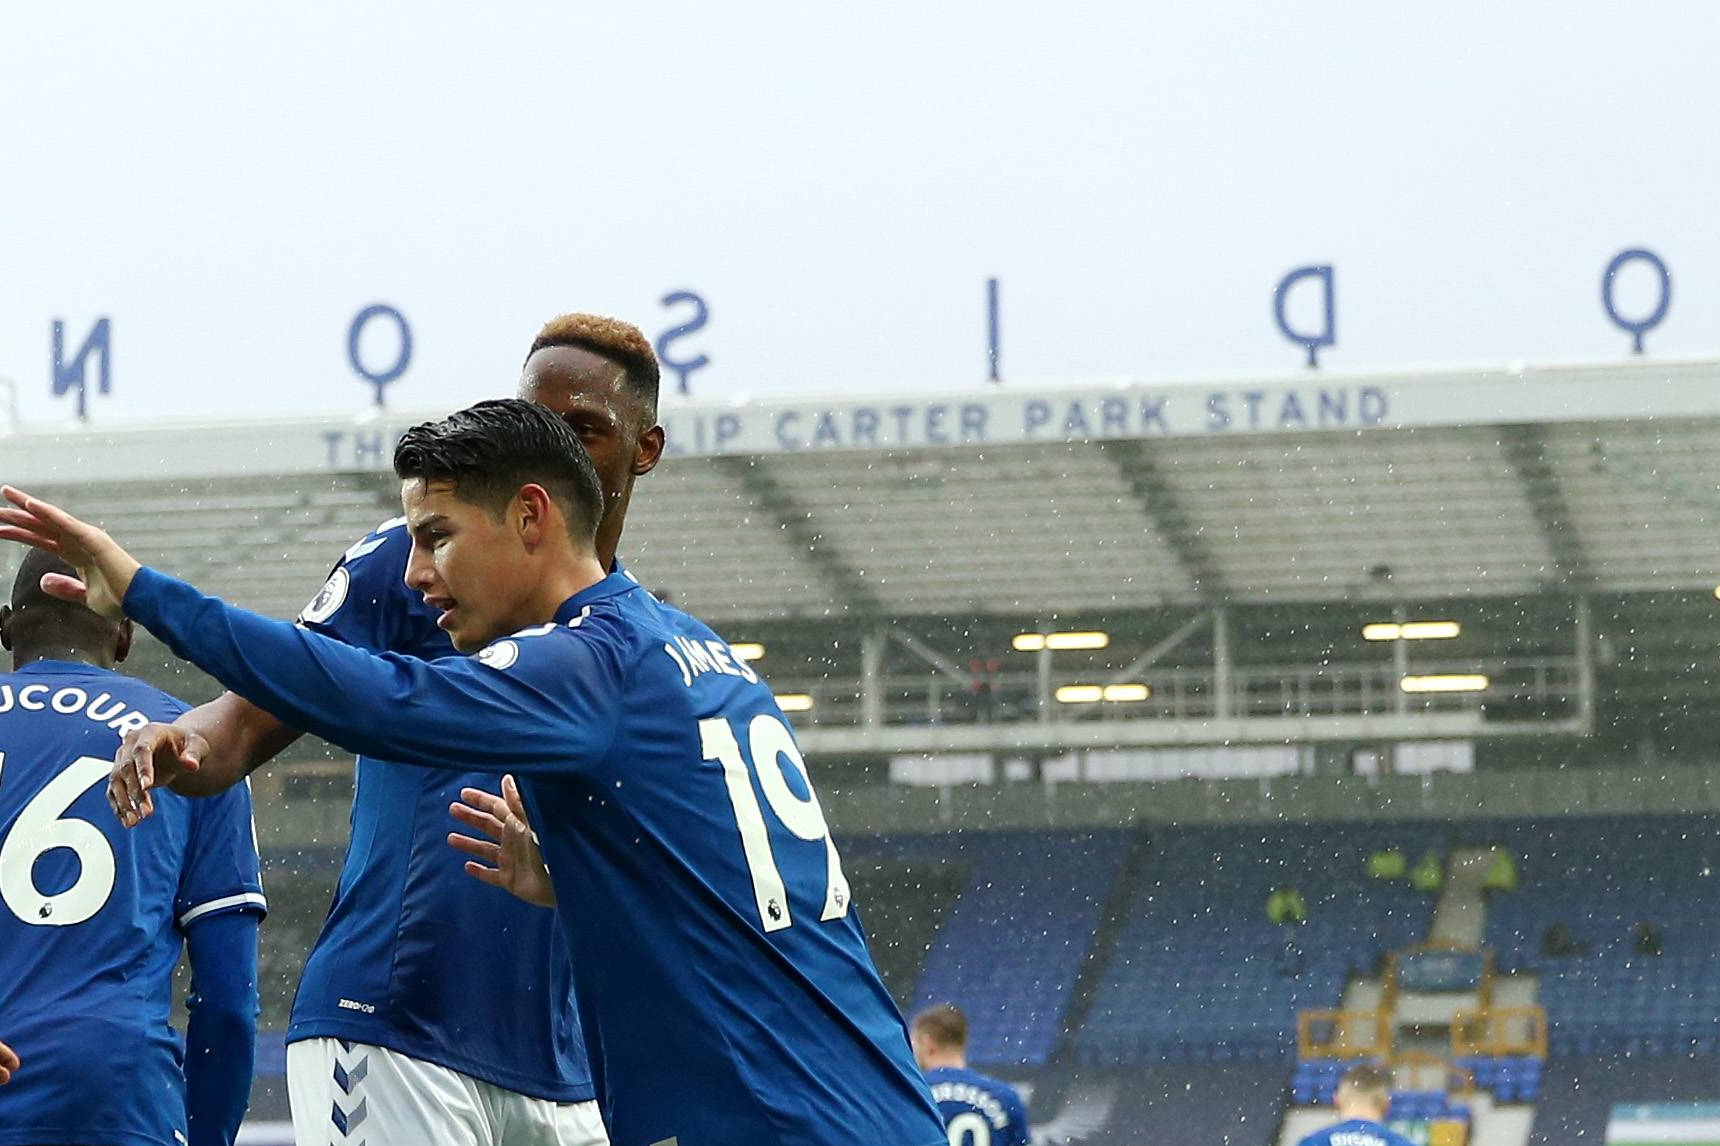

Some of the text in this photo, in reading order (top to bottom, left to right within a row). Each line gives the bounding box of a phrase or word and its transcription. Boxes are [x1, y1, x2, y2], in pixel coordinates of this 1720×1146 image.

[664, 413, 741, 454] LIP
[777, 403, 991, 450] CARTER
[1023, 394, 1169, 440] PARK
[1205, 385, 1392, 427] STAND
[698, 714, 852, 932] 19
